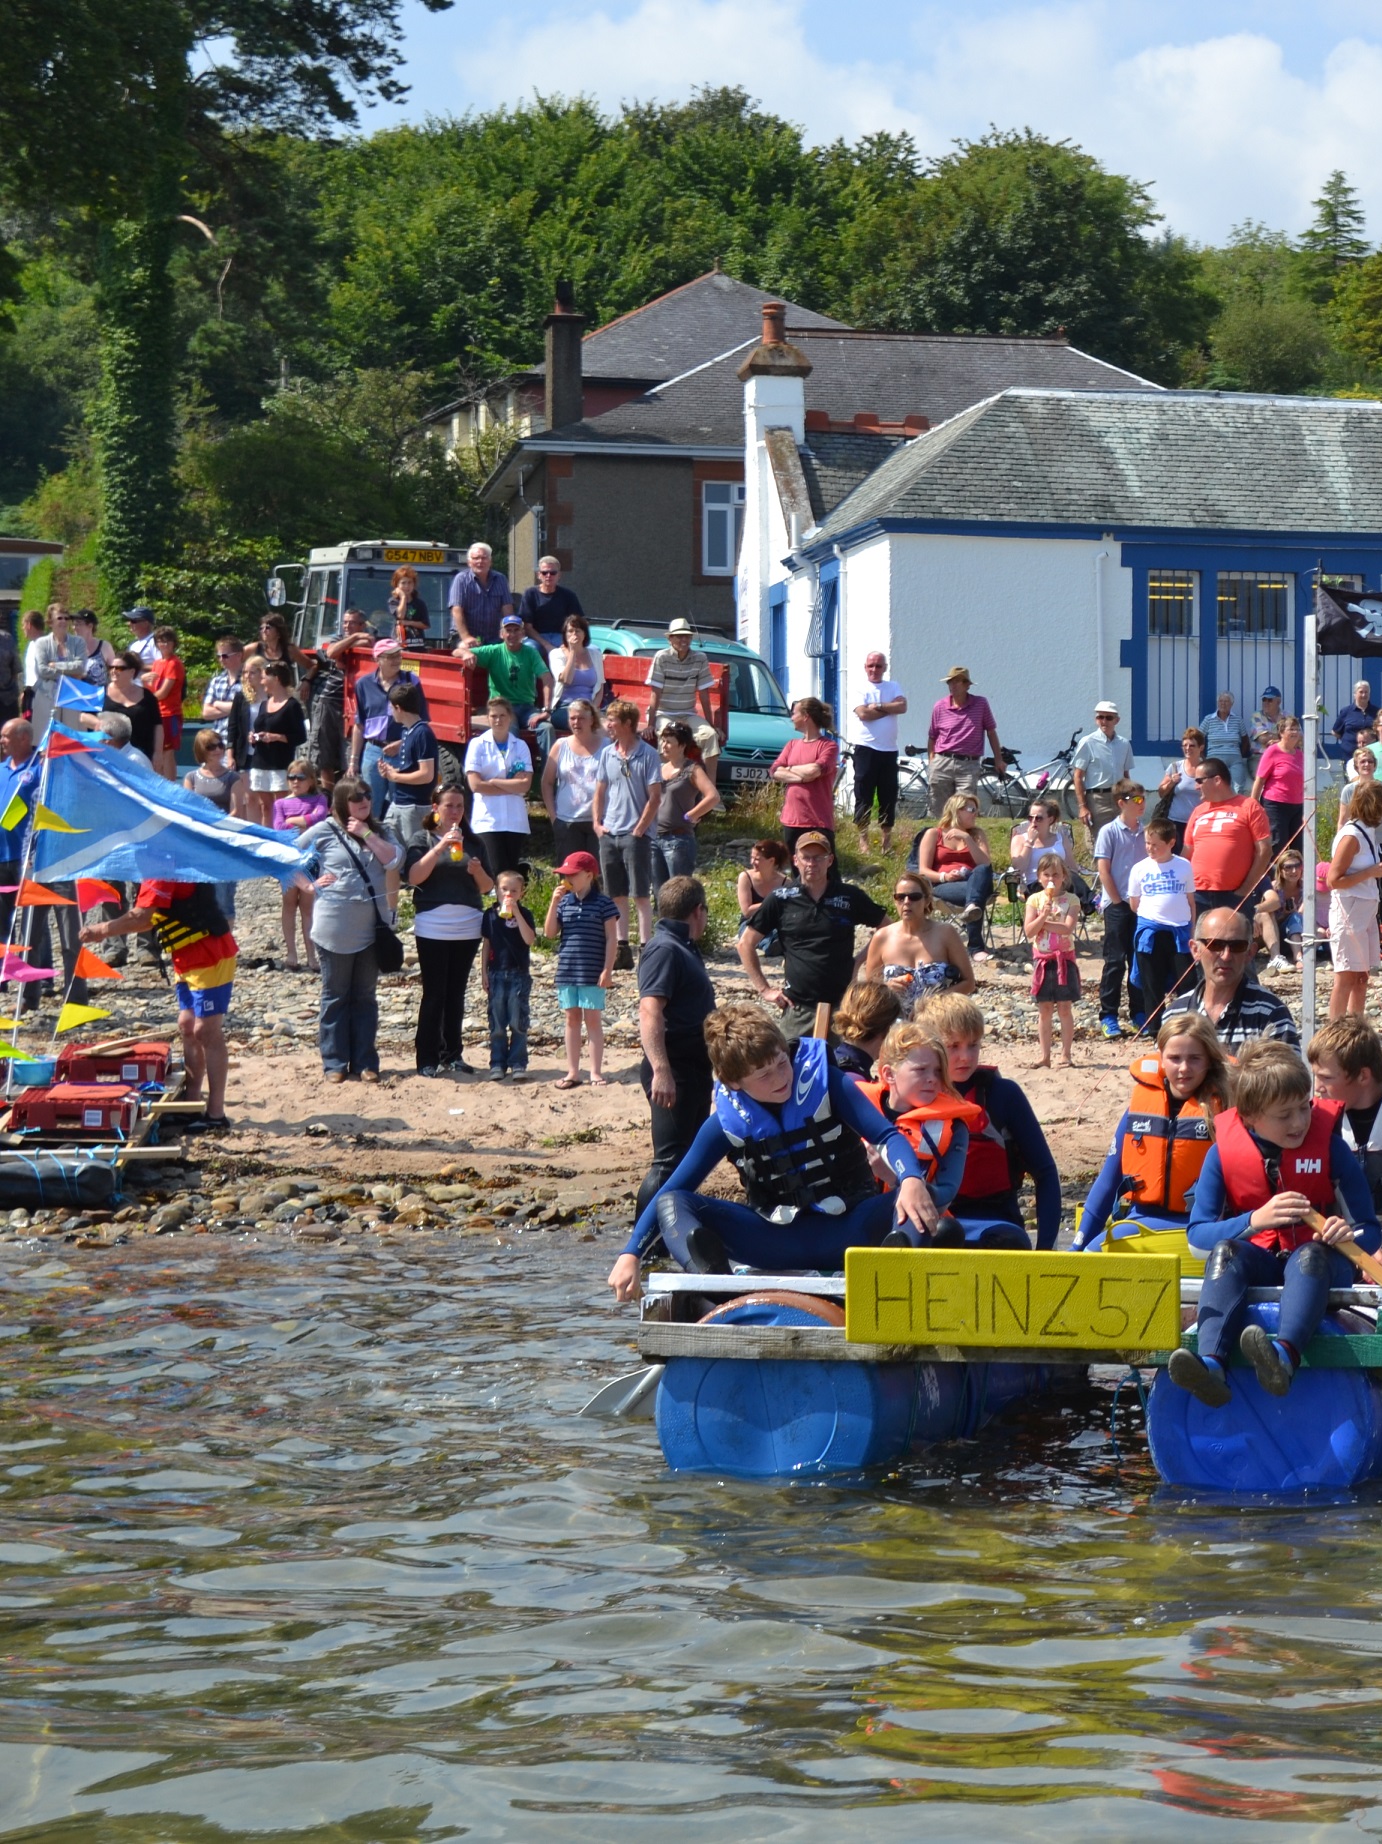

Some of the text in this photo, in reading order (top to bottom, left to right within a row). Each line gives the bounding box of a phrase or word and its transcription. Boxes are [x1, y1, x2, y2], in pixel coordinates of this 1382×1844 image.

[736, 767, 763, 779] SJ02
[874, 1270, 1173, 1341] HEINZ 57
